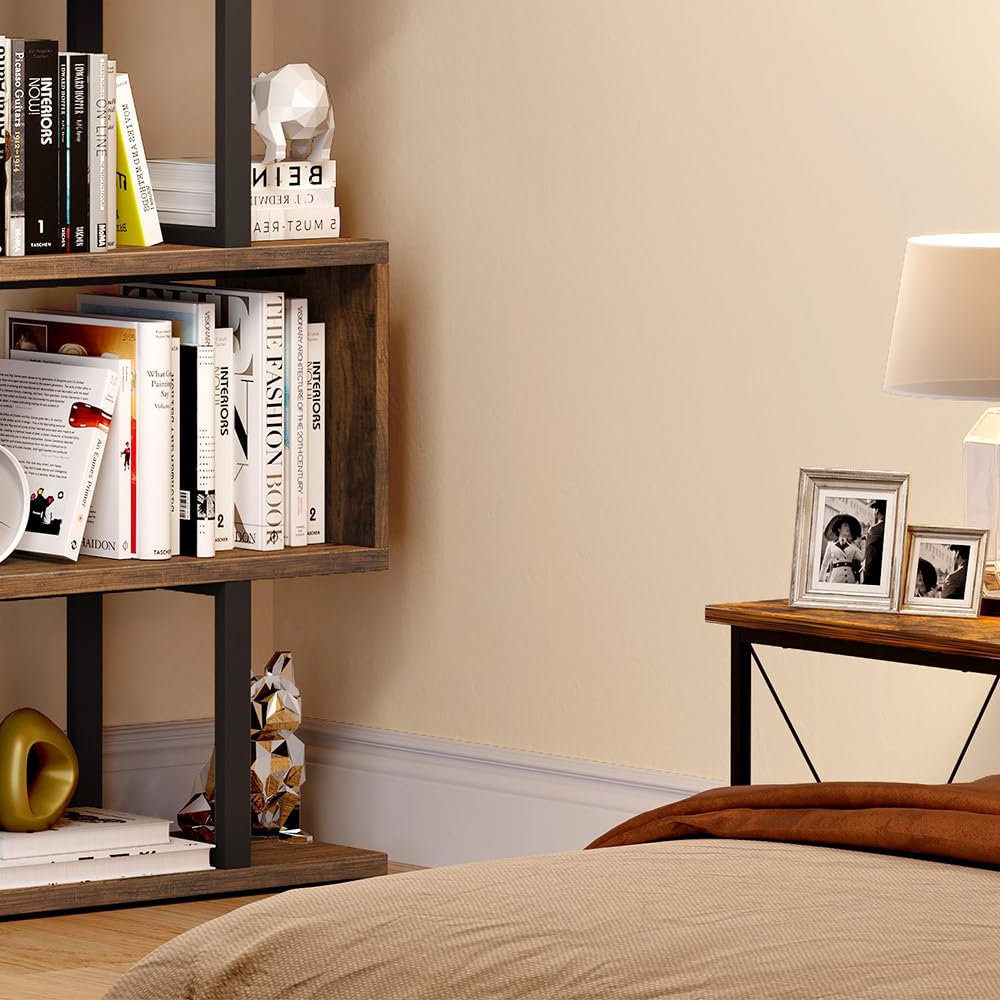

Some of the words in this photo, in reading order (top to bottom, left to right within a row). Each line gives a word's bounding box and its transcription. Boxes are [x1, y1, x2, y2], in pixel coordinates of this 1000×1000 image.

[13, 51, 24, 88] Picasso
[74, 63, 85, 89] EDWARD
[13, 89, 24, 128] Guitars
[28, 77, 41, 116] NOW!
[40, 77, 53, 145] INTERIORS
[74, 90, 85, 114] HOPPER
[96, 98, 107, 119] ON
[96, 125, 107, 157] LINE
[37, 219, 45, 234] 1
[75, 226, 85, 247] TASCHEN
[97, 223, 106, 248] MoMA
[266, 296, 284, 350] THE
[296, 306, 304, 344] VISIONARY
[296, 344, 304, 401] ARCHITECTURE
[220, 366, 230, 437] INTERIORS
[265, 355, 284, 467] FASHION
[312, 361, 321, 430] INTERIORS
[296, 413, 304, 430] THE
[94, 438, 103, 450] An
[88, 451, 100, 479] Eames
[296, 457, 304, 495] CENTURY
[81, 480, 93, 510] Primer
[216, 514, 223, 528] 2
[308, 507, 316, 521] 2
